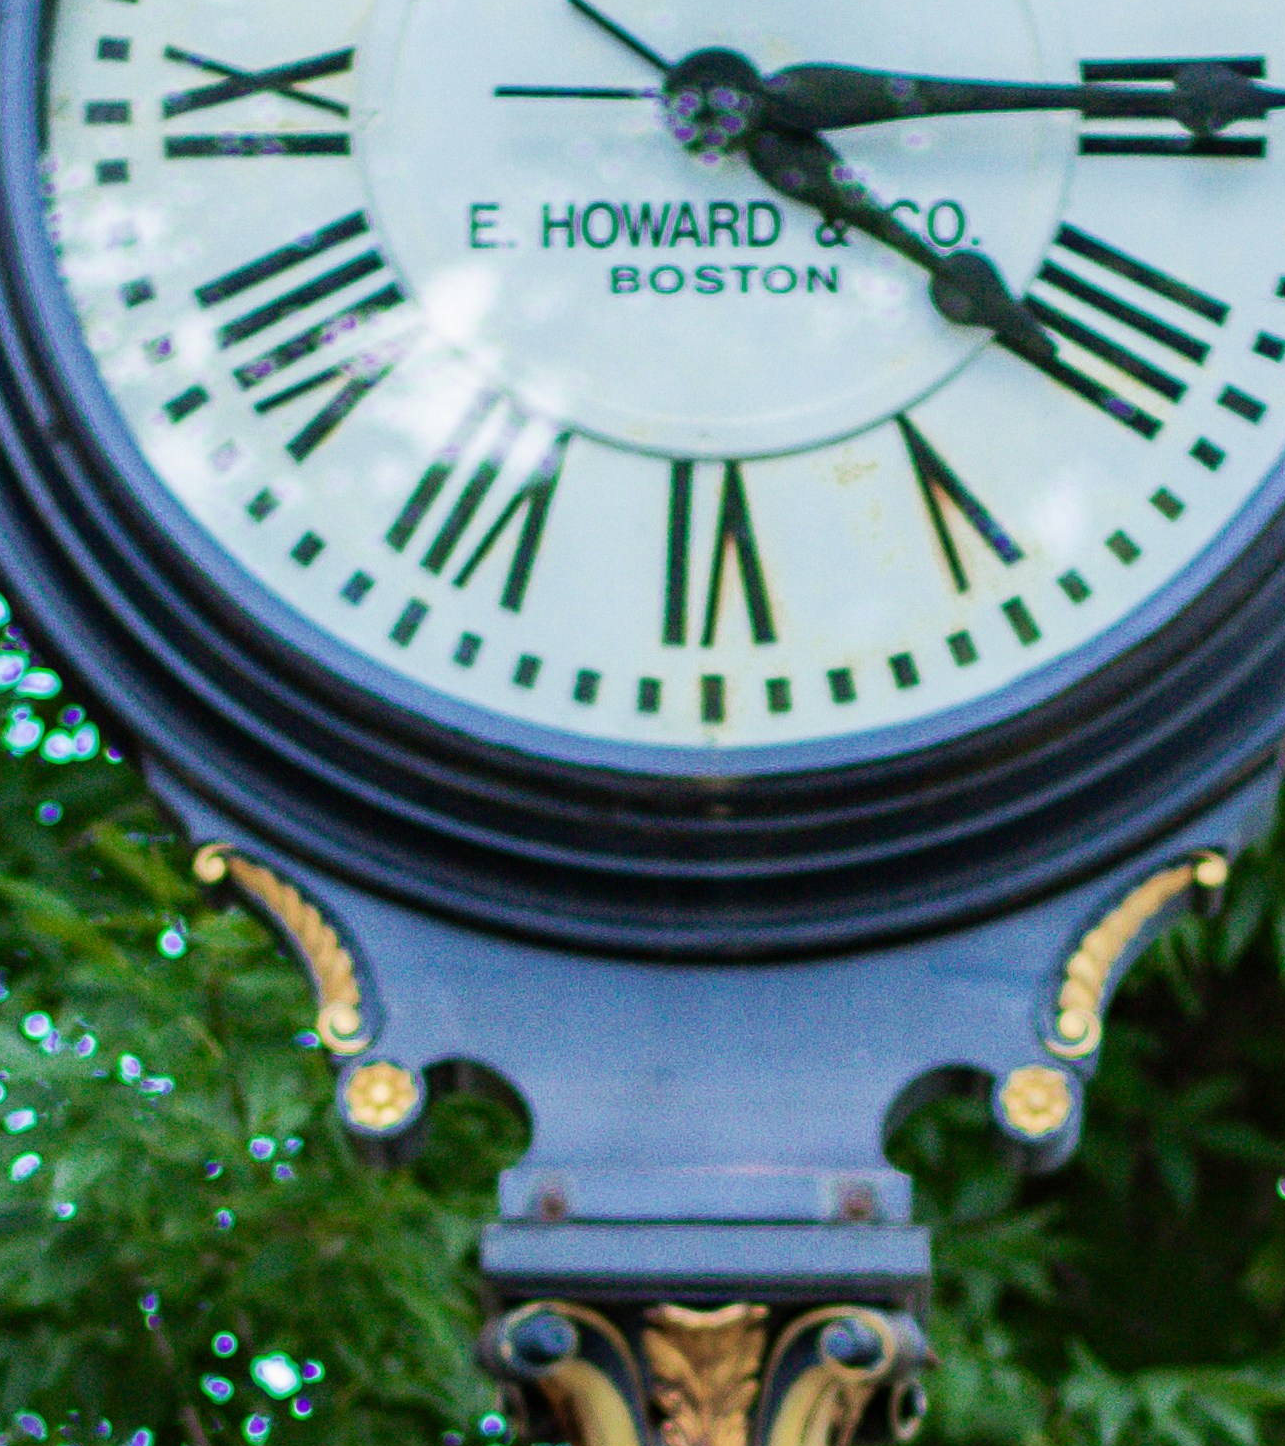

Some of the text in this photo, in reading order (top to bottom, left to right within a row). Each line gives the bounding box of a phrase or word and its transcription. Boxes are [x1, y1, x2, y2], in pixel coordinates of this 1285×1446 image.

[162, 45, 355, 159] IX
[469, 202, 516, 249] E.
[540, 201, 782, 250] HOWARD
[610, 264, 839, 295] BOSTON
[194, 209, 408, 466] VIII
[385, 390, 574, 614] VII
[662, 460, 777, 648] VI
[894, 412, 1026, 594] V
